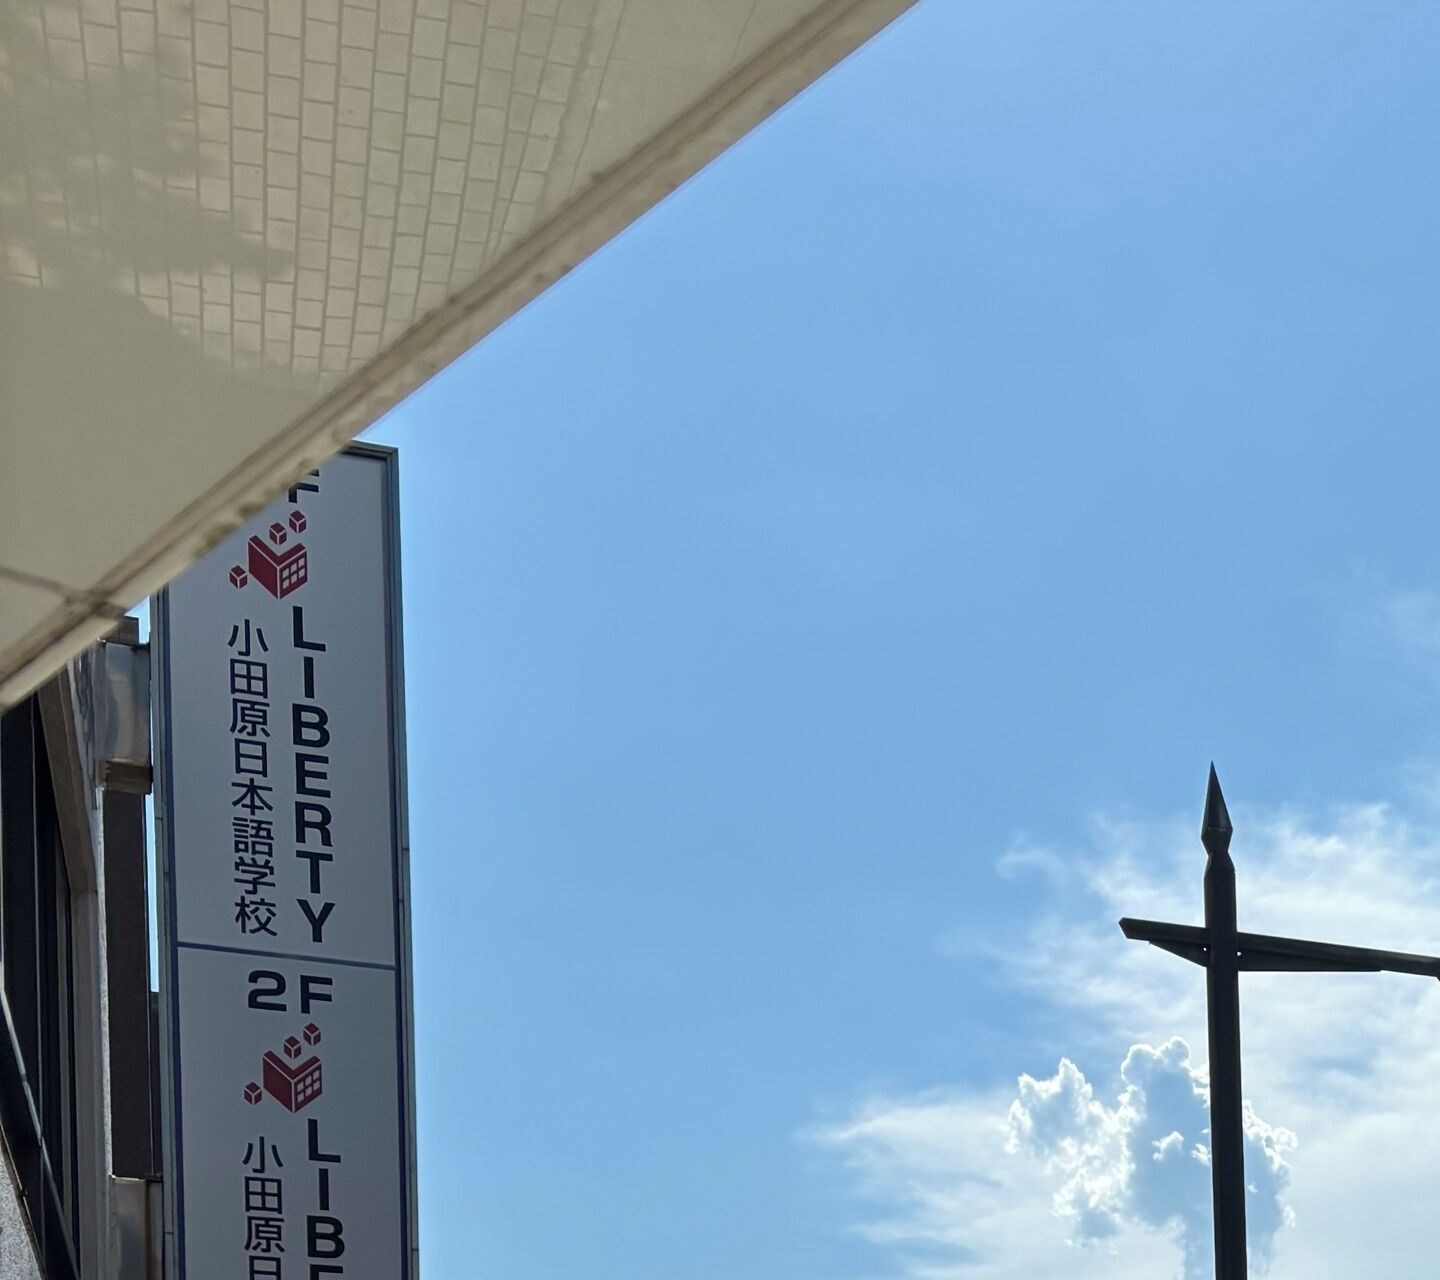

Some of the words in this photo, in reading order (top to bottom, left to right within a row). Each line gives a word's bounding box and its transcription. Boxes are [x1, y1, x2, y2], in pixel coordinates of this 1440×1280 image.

[227, 618, 278, 937] 小田原日本語学校
[291, 605, 335, 943] LIBERTY
[246, 970, 334, 1014] 2F
